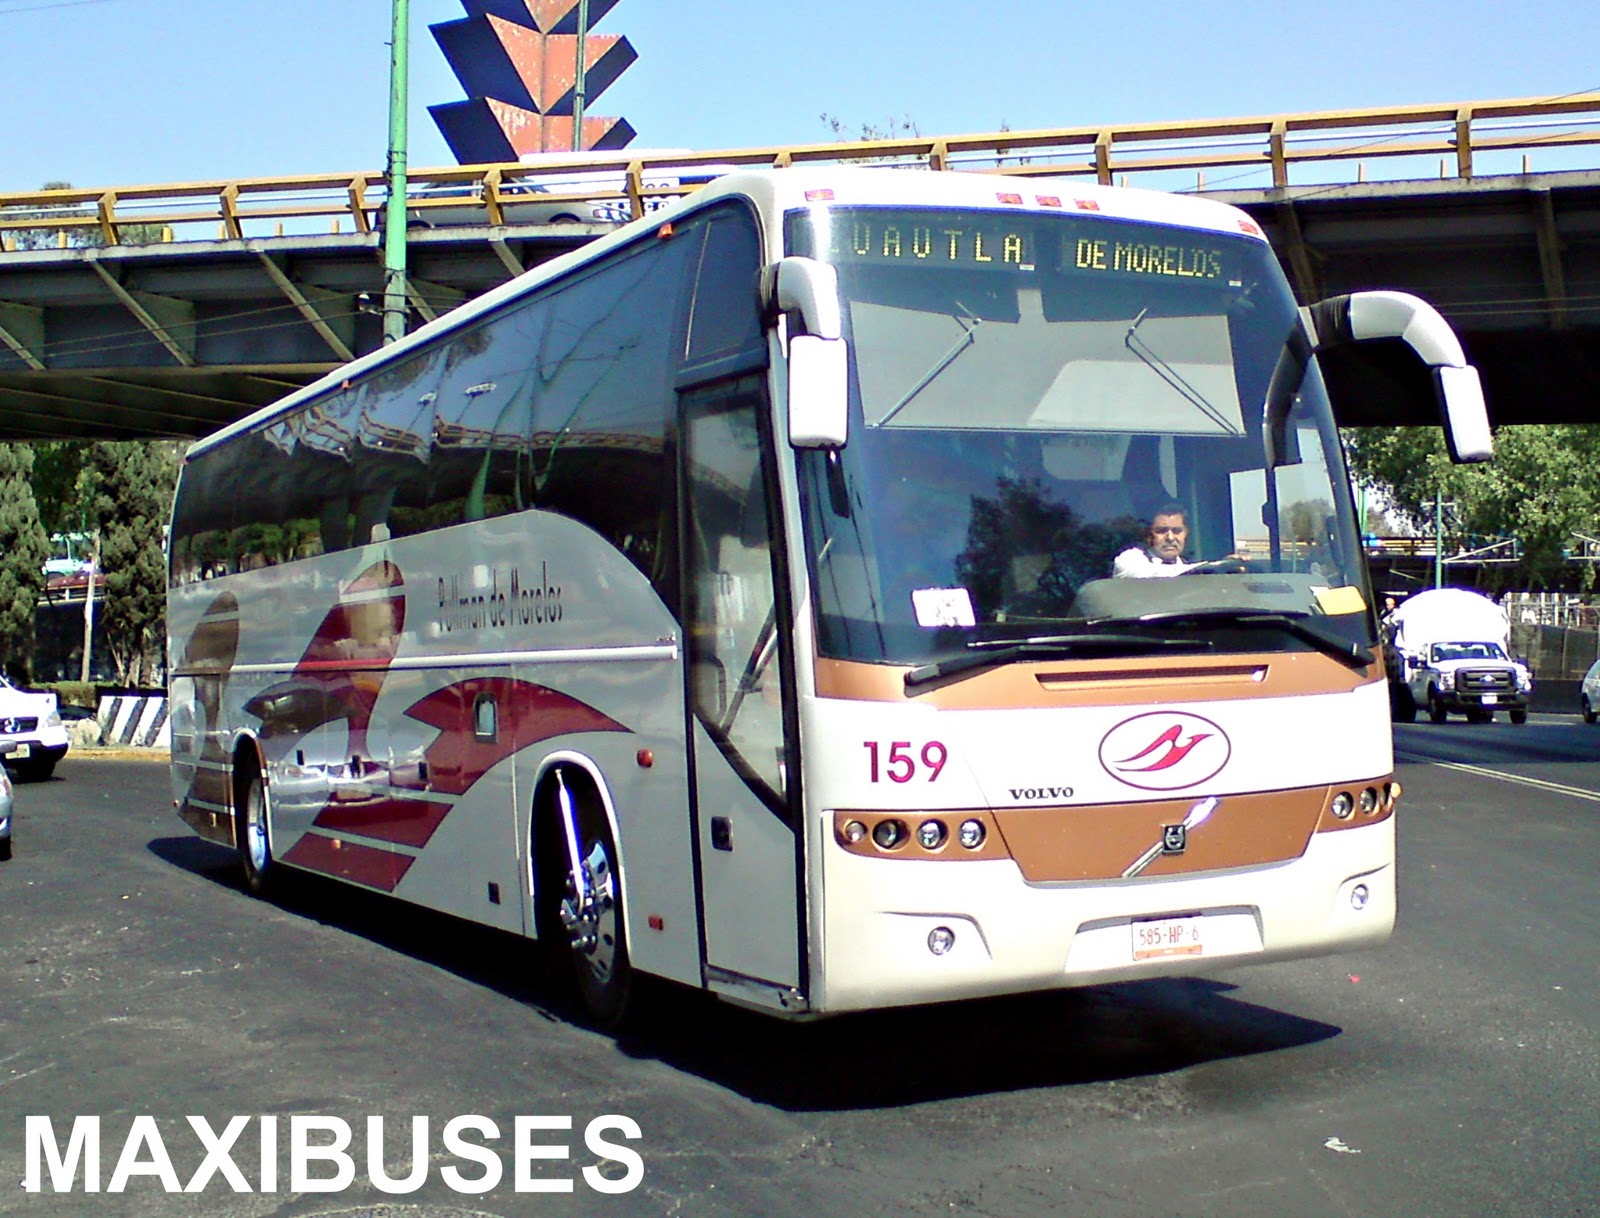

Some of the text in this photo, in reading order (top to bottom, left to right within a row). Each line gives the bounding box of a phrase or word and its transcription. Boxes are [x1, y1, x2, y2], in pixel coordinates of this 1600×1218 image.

[828, 220, 1222, 279] UAUTLA DE MORELOS
[490, 567, 506, 628] de
[510, 560, 564, 626] Morelos
[863, 740, 948, 784] 159
[1008, 786, 1075, 801] VOLVO
